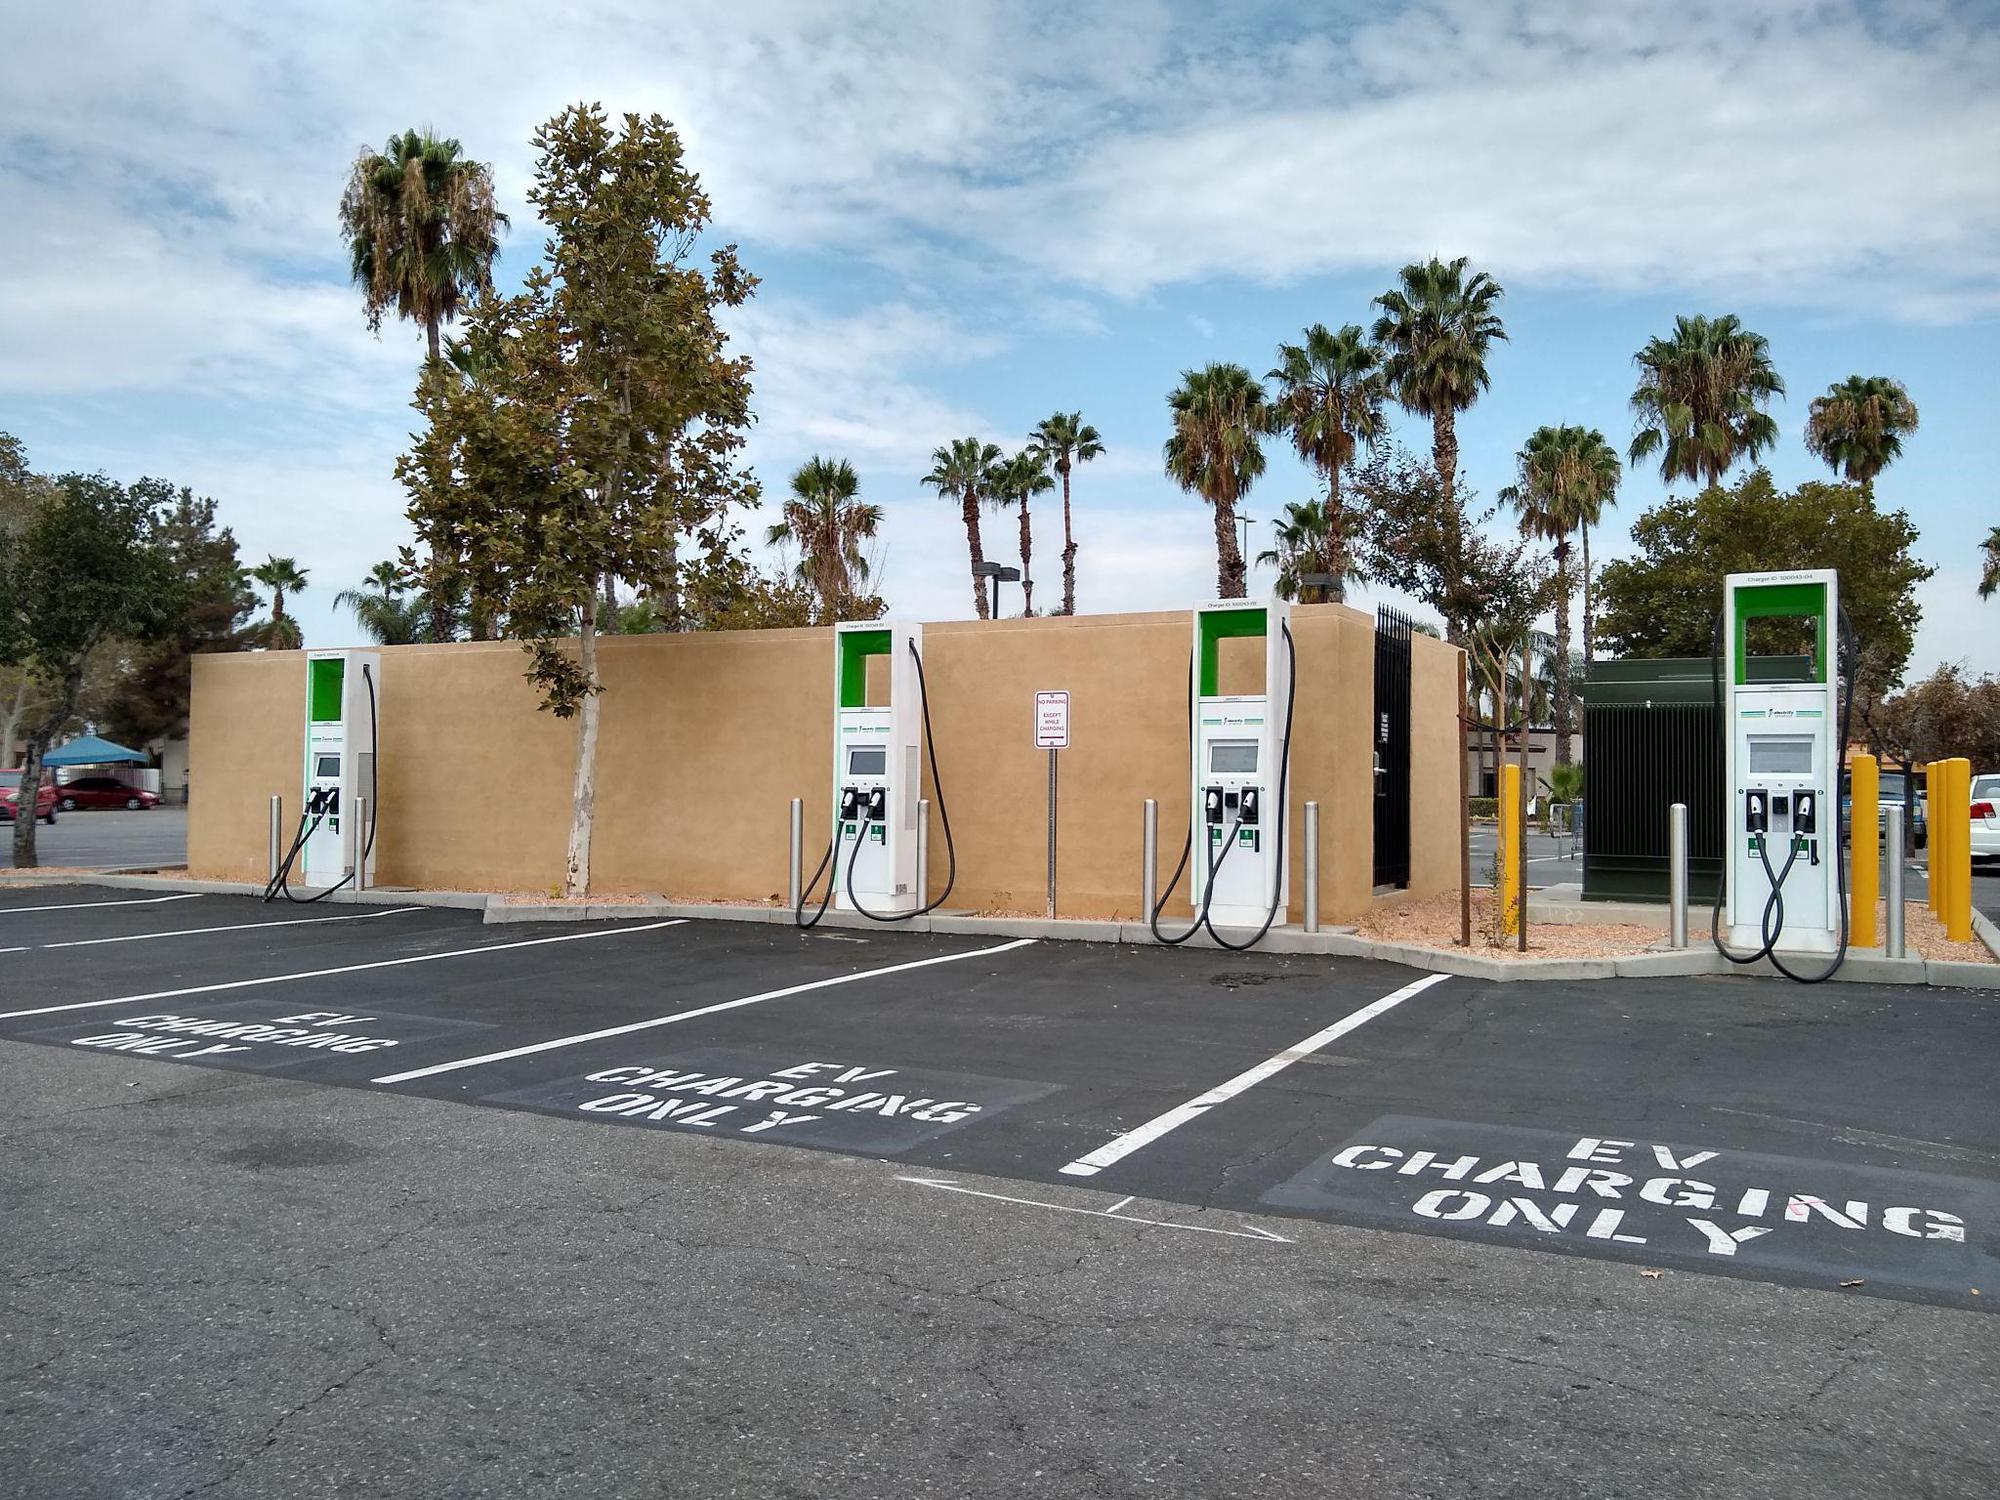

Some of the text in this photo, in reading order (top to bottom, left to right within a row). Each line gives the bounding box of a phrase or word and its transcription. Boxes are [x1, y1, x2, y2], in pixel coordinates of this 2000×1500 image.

[113, 1015, 399, 1053] CHARGING
[271, 1012, 377, 1026] EV
[71, 1033, 252, 1058] ONLY
[769, 1062, 899, 1083] EV
[578, 1093, 822, 1133] ONLY
[584, 1066, 981, 1123] CHARGING
[1566, 1138, 1720, 1170] EV
[1331, 1145, 1966, 1243] CHARGING
[1411, 1189, 1773, 1256] ONLY
